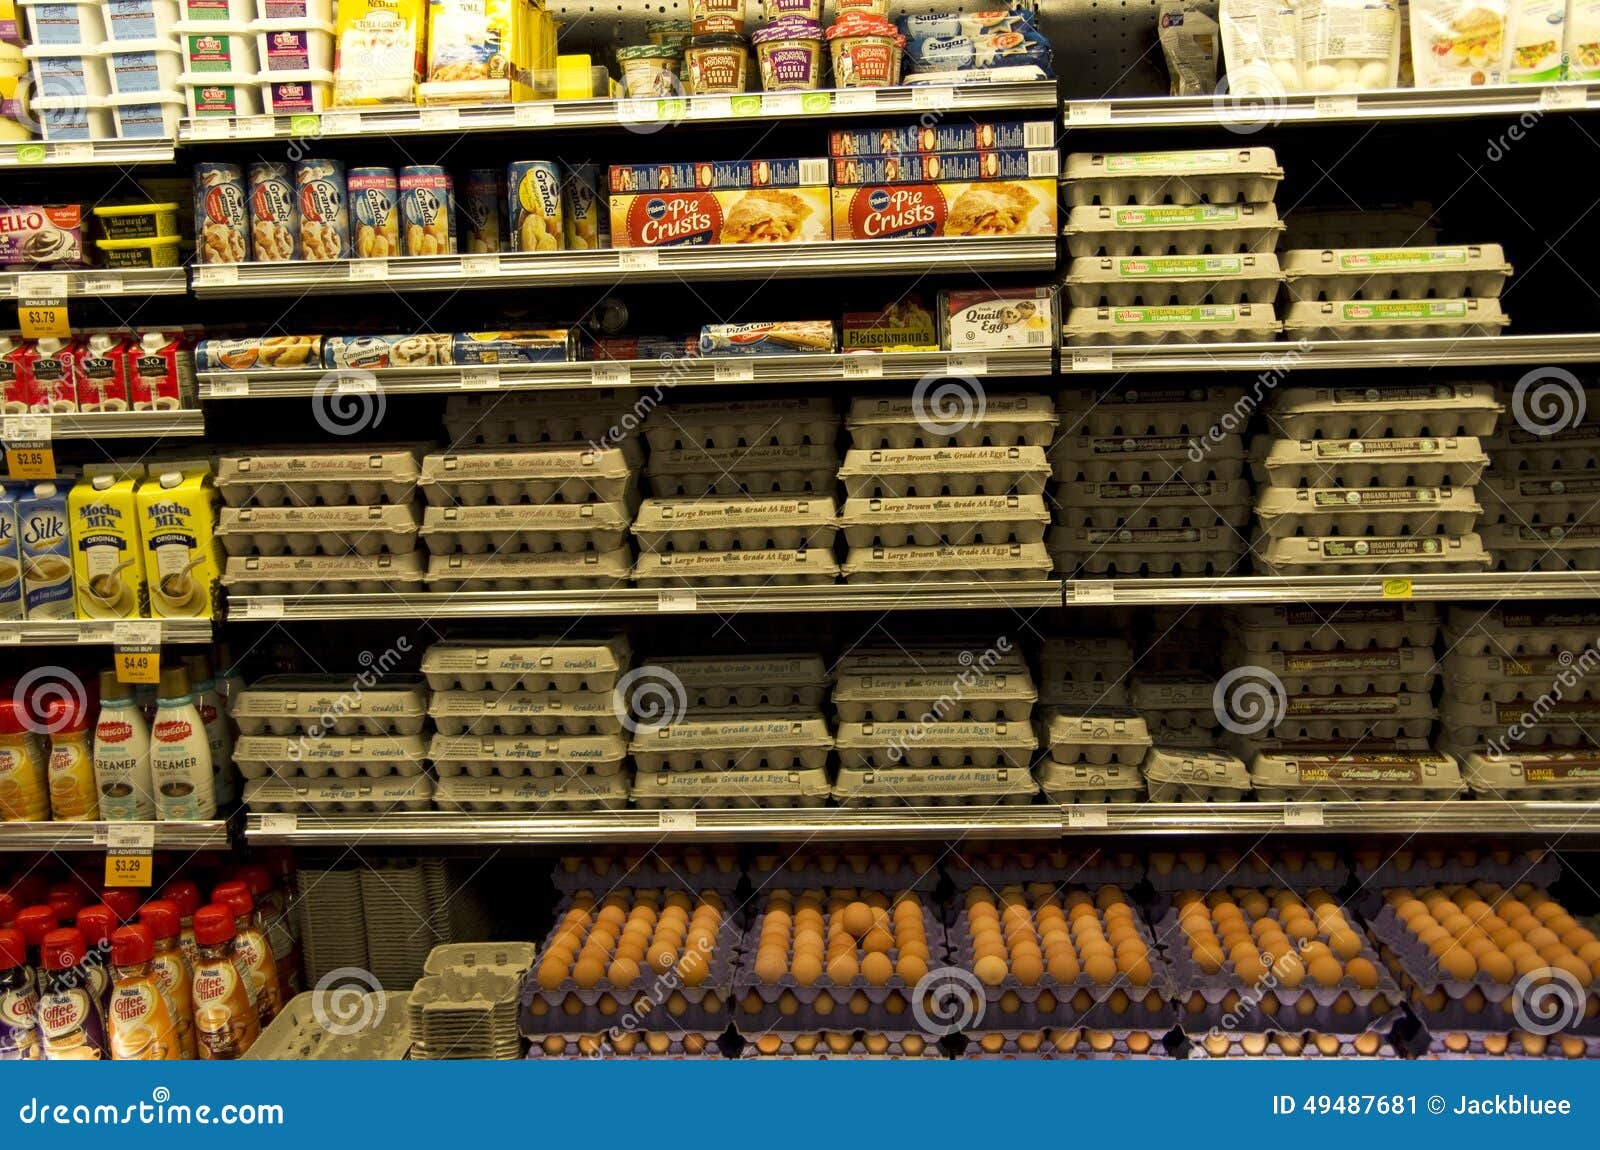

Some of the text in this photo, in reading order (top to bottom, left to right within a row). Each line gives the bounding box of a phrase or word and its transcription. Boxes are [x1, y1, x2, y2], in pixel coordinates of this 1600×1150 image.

[915, 13, 950, 25] Sugar
[929, 38, 967, 50] Sugar
[706, 69, 734, 77] COOKIE
[777, 65, 805, 73] COOKIE
[535, 168, 557, 218] Grands!
[225, 187, 243, 226] Grands!
[269, 184, 289, 222] Grands!
[317, 184, 336, 222] Grands!
[416, 188, 435, 226] Grands!
[891, 190, 924, 212] Pie
[367, 189, 387, 227] Grands!
[667, 199, 699, 220] Pie
[54, 211, 77, 219] original
[863, 204, 936, 236] Crusts
[0, 212, 44, 233] ELL-O
[641, 212, 712, 244] Crusts
[28, 311, 55, 324] $3.79
[966, 309, 1001, 323] Quail
[726, 326, 748, 335] Pizza
[980, 320, 1009, 334] Eggs
[849, 329, 930, 345] Fleischmann's
[342, 347, 374, 360] Cinnamon
[40, 361, 56, 369] SO
[91, 358, 107, 368] SO
[144, 356, 160, 366] SO
[17, 453, 43, 465] $2.85
[884, 455, 905, 463] Large
[954, 451, 976, 459] Grade
[989, 450, 1006, 460] Eggs
[80, 503, 123, 519] Mocha
[148, 502, 192, 519] Mocha
[884, 504, 905, 512] Large
[988, 500, 1006, 508] Eggs
[87, 515, 116, 529] Mix
[155, 514, 185, 528] Mix
[24, 516, 64, 544] Silk
[87, 535, 118, 544] ORIGINAL
[156, 535, 188, 544] ORIGINAL
[124, 657, 148, 669] $4.49
[671, 729, 698, 738] Large
[721, 726, 749, 734] Grade
[875, 727, 902, 736] Large
[926, 727, 954, 735] Grade
[95, 759, 137, 770] CREAMER
[153, 757, 197, 770] CREAMER
[1527, 768, 1555, 776] LARGE
[115, 860, 140, 872] $3.29
[200, 986, 225, 1000] mate
[120, 1005, 147, 1021] mate
[49, 1012, 77, 1029] mate
